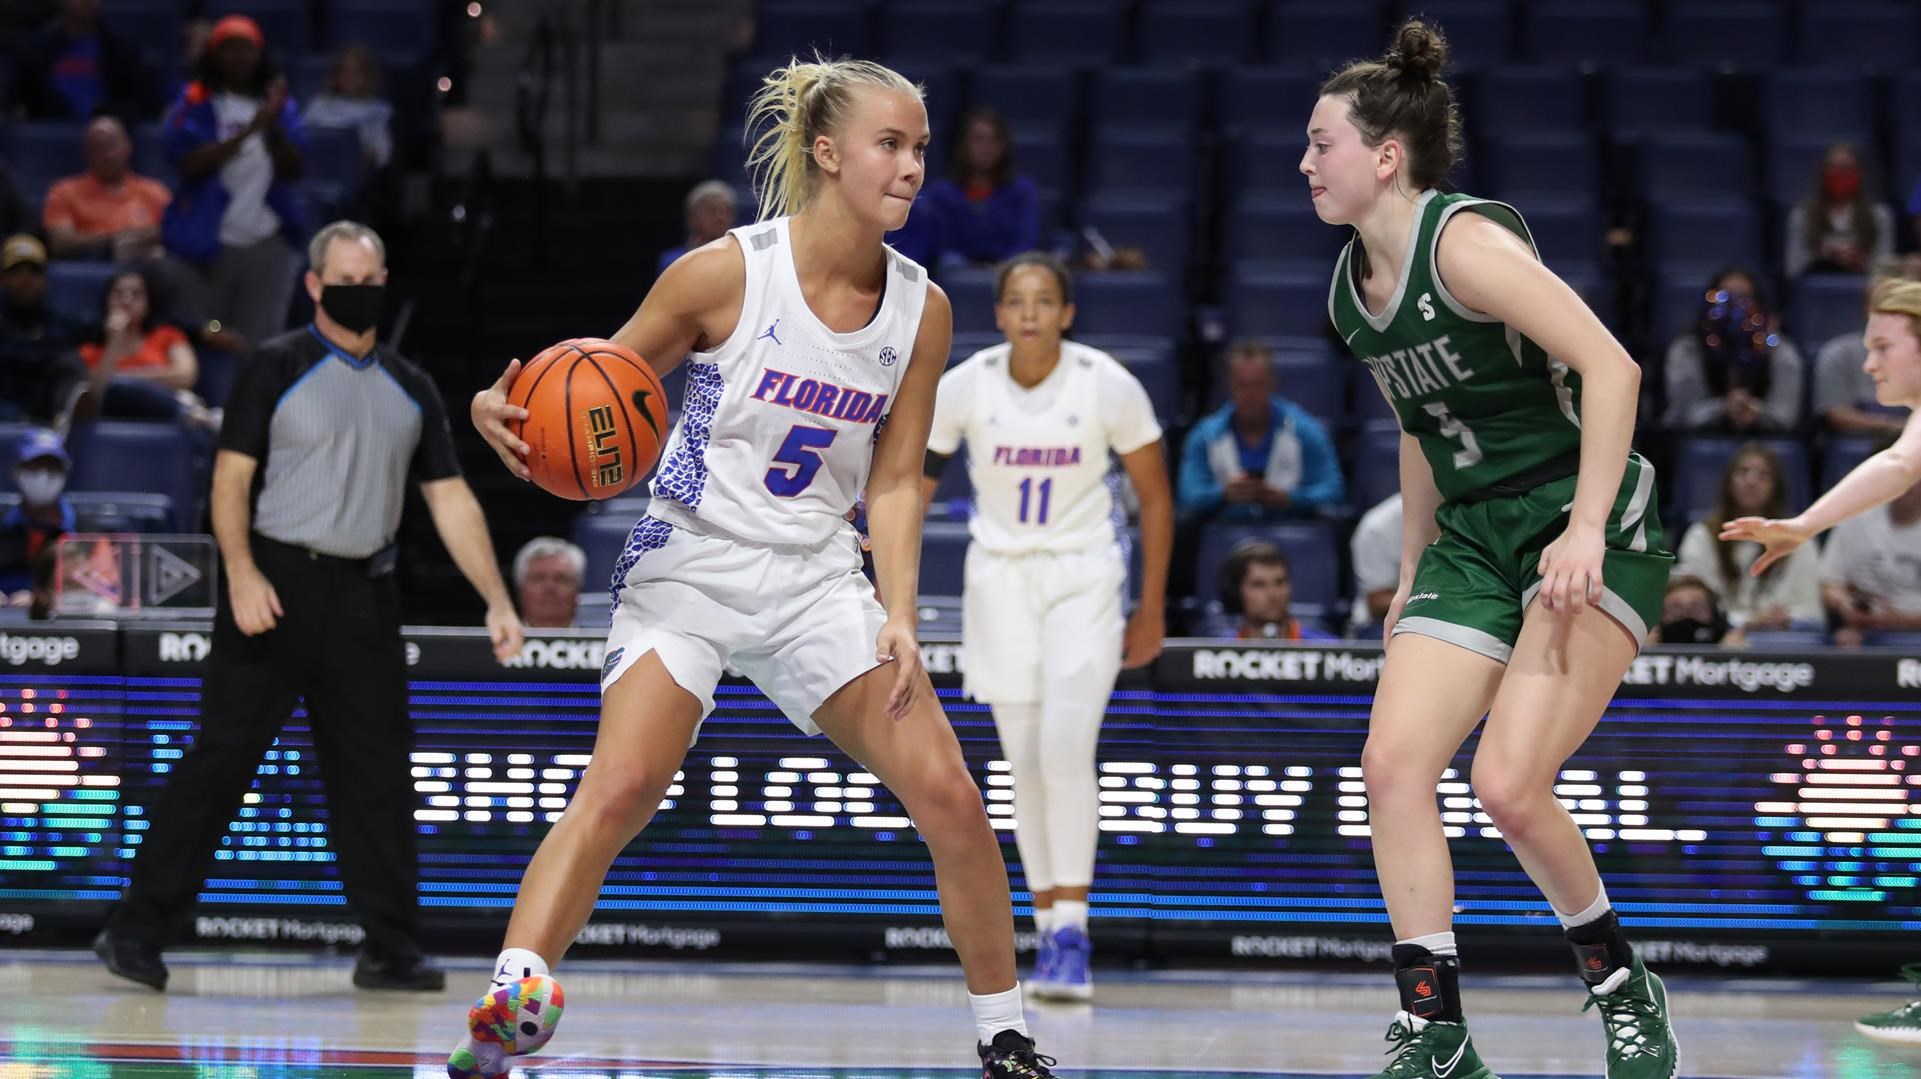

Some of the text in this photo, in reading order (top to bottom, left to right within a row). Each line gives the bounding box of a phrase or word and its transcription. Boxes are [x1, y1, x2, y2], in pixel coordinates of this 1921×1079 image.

[880, 348, 896, 365] SEC
[749, 367, 889, 424] FLORIDA
[588, 404, 624, 488] ELITE
[764, 424, 839, 498] 5
[992, 446, 1081, 468] FLORIDA
[1018, 477, 1052, 525] 11
[1193, 650, 1322, 681] ROCKET
[1675, 656, 1815, 692] Mortgage
[1098, 762, 1313, 835] BUY
[196, 916, 279, 939] ROCKET
[627, 924, 721, 950] Mortgage
[1231, 935, 1318, 958] ROCKET
[1673, 941, 1769, 966] Mortgage
